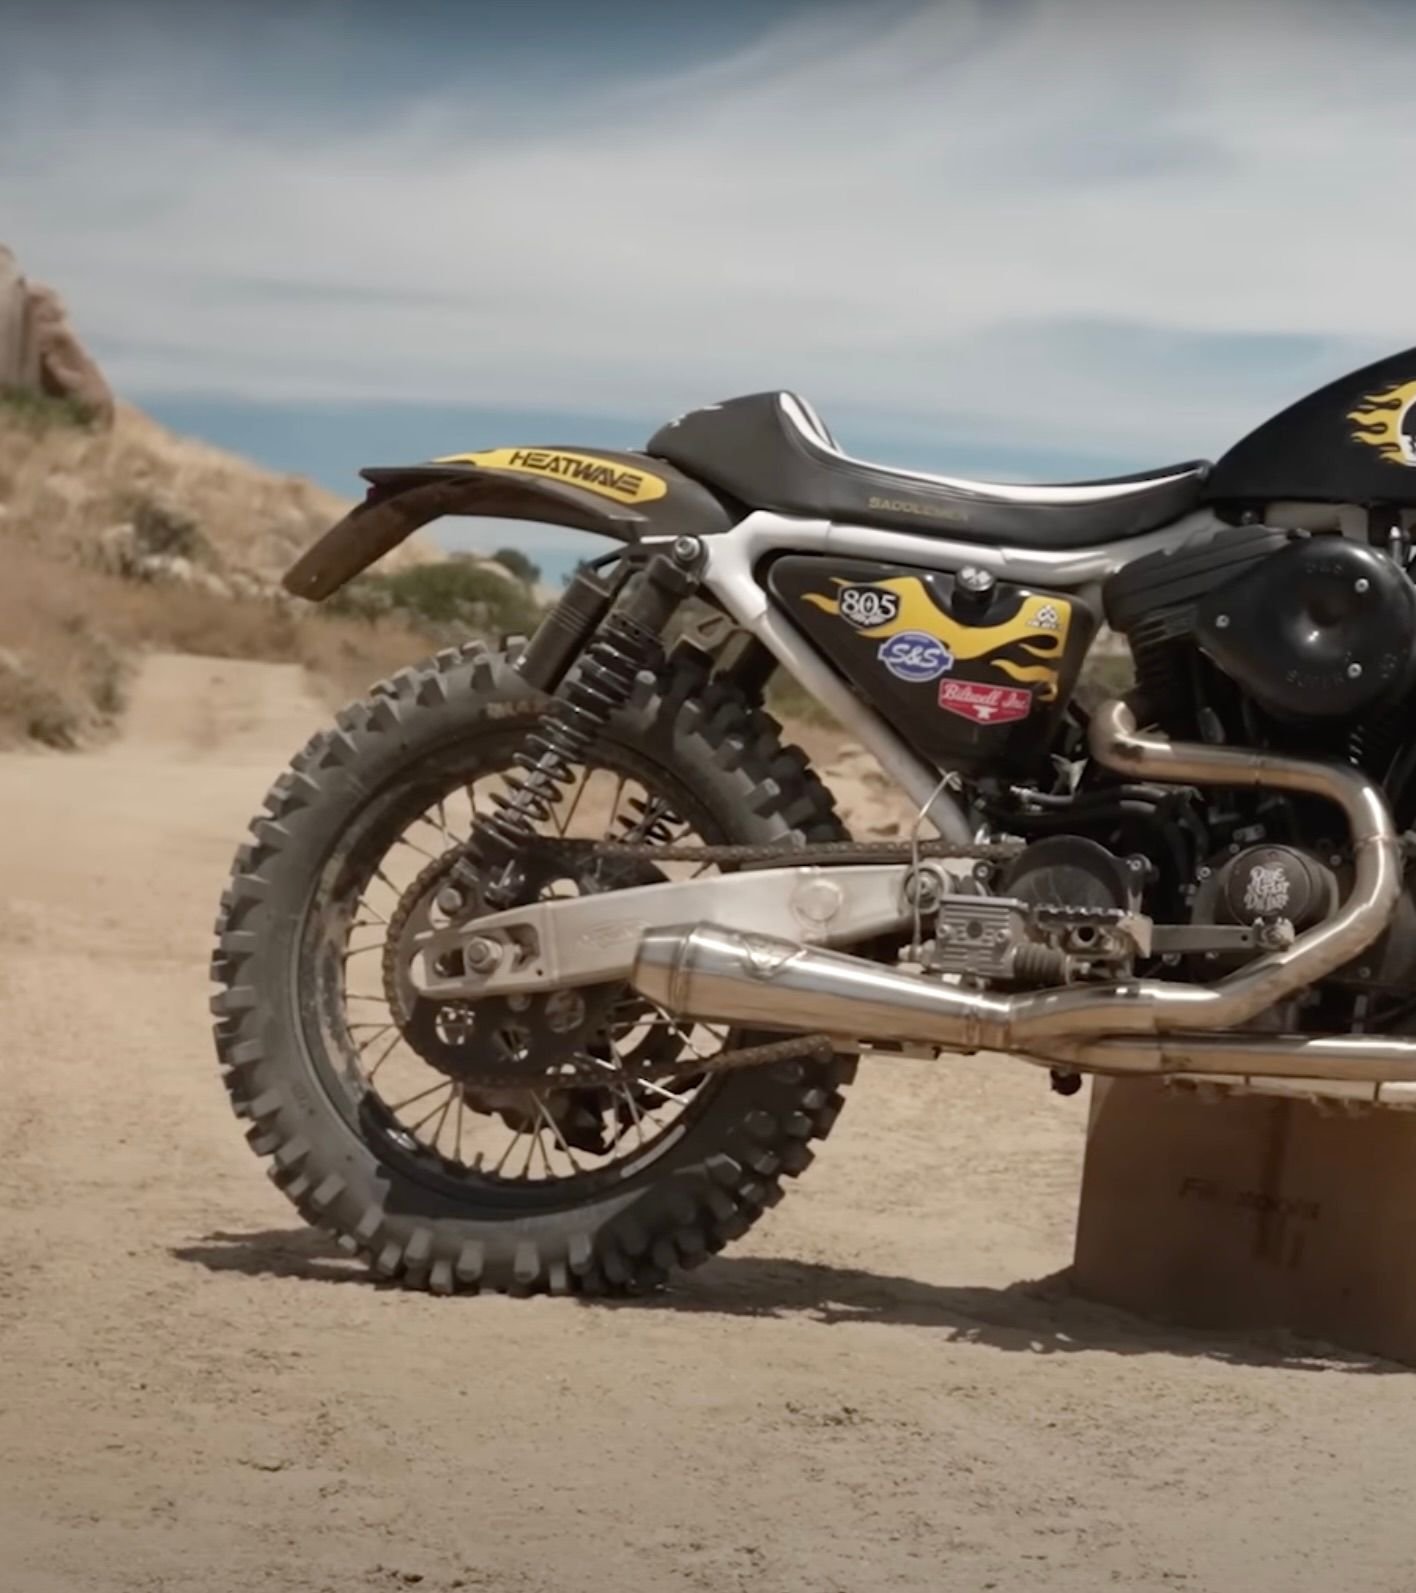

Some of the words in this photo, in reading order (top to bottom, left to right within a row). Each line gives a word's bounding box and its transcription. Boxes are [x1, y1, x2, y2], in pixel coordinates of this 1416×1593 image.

[509, 451, 643, 497] HEATWAVE
[841, 589, 897, 619] 805
[888, 643, 940, 668] S&S
